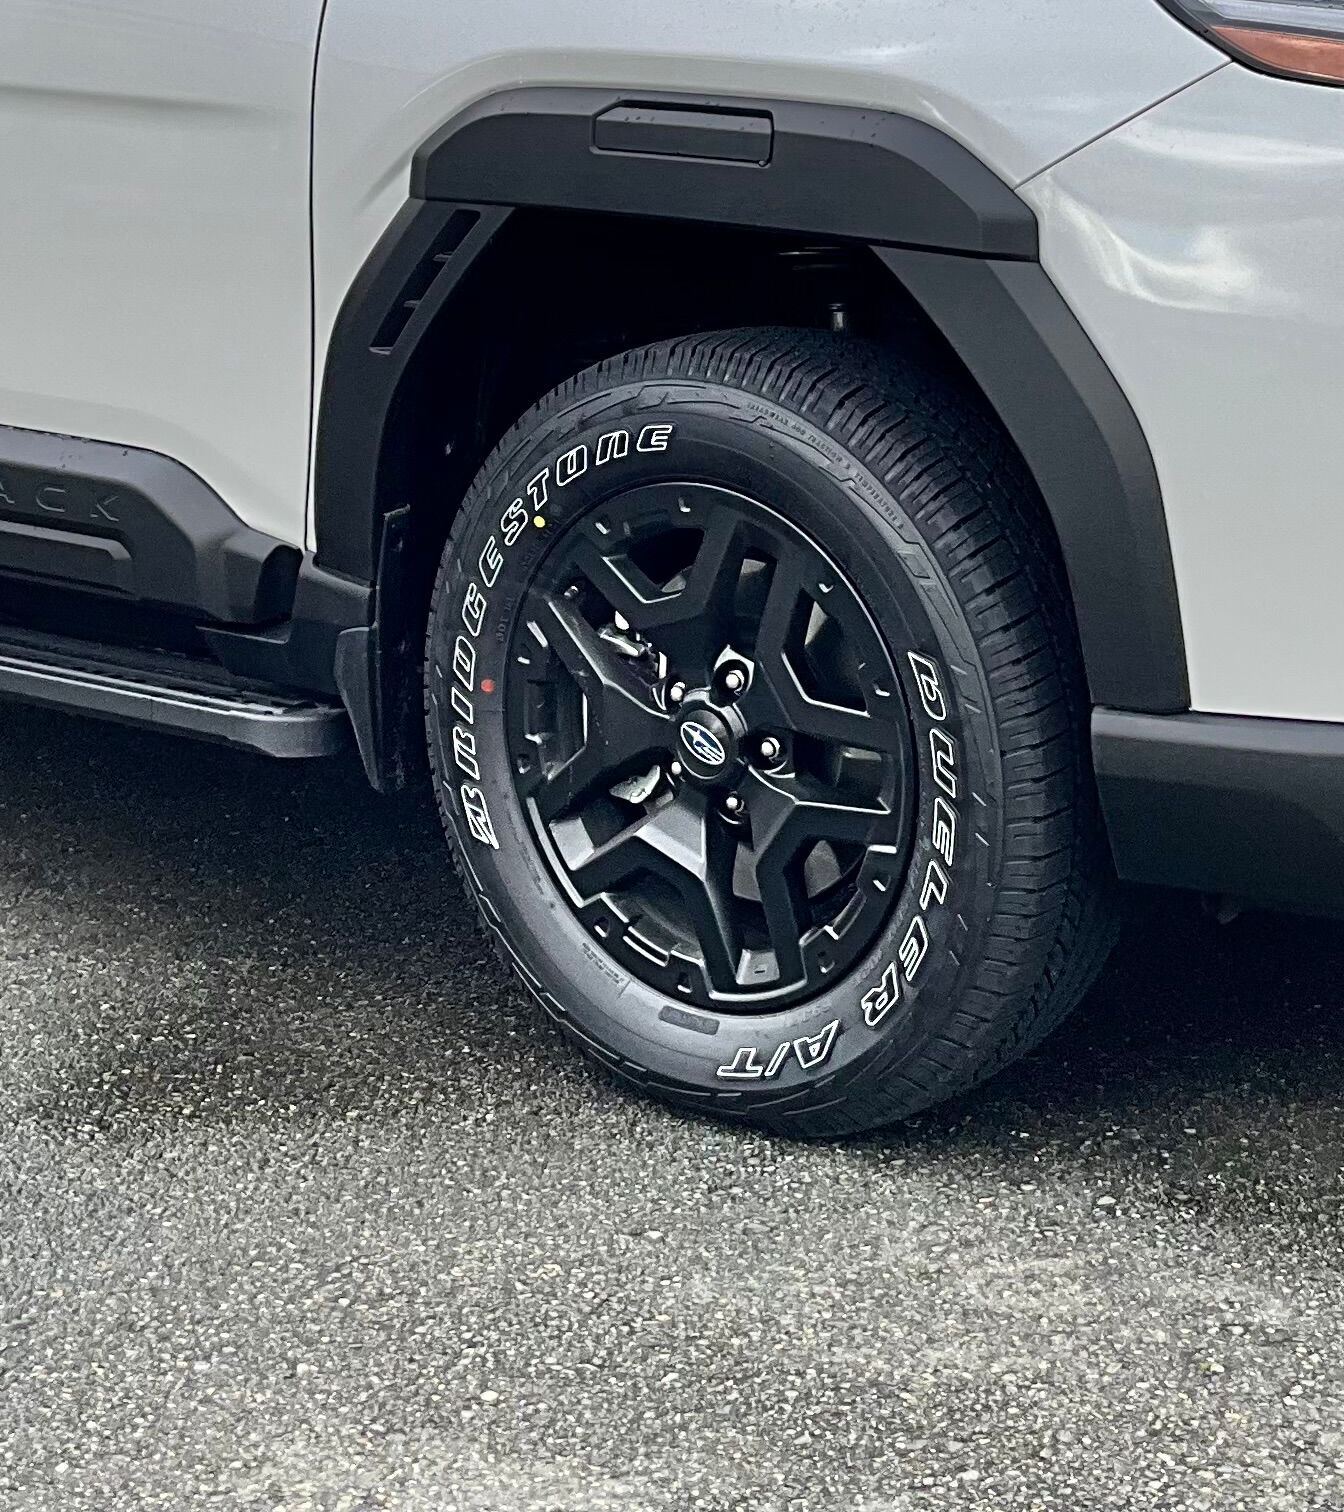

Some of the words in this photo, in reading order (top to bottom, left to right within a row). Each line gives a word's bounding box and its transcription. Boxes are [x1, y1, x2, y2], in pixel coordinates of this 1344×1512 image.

[452, 424, 674, 850] BRIDGESTONE
[863, 650, 958, 1026] DUELER
[716, 1019, 840, 1079] A/T
